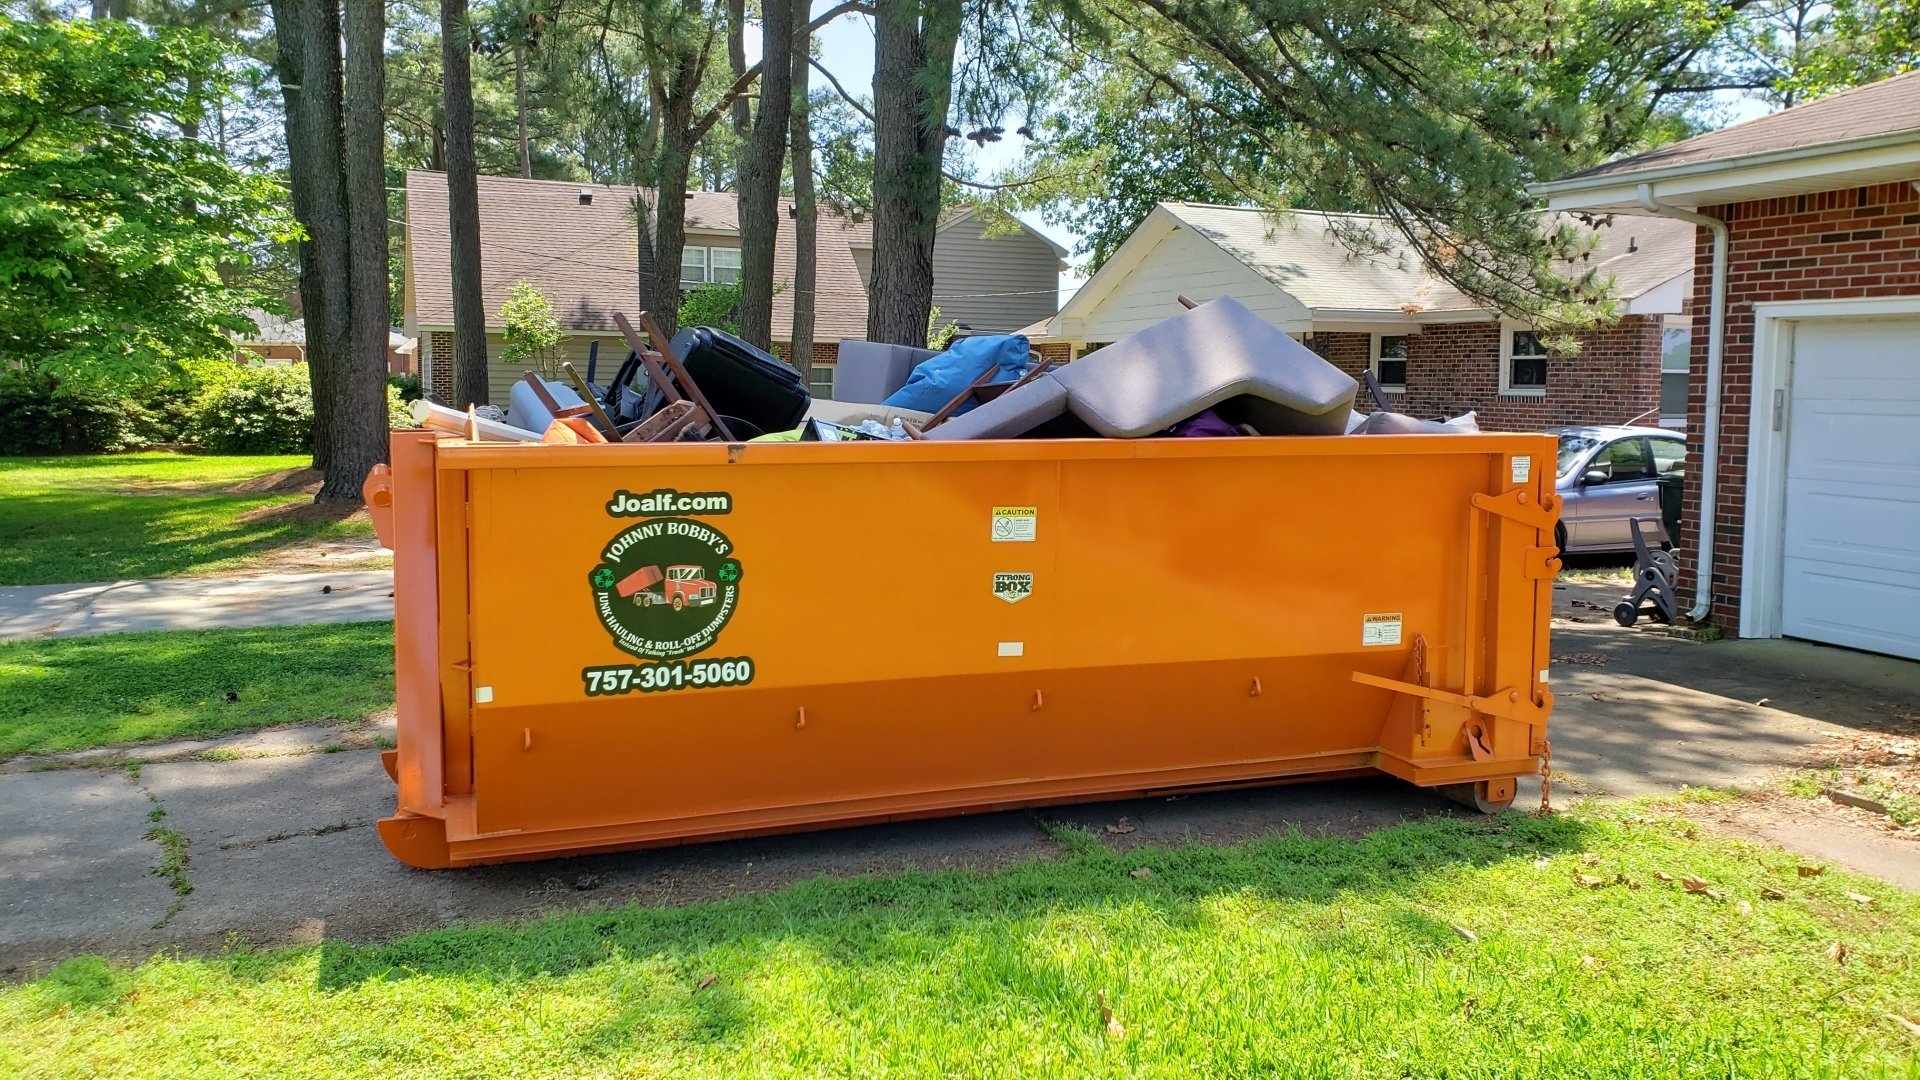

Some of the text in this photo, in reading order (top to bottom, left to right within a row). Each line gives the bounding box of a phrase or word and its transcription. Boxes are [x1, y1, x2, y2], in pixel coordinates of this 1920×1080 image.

[611, 494, 727, 512] Joalf.com
[606, 522, 728, 563] JOHNNY BOBBY'S
[995, 581, 1030, 592] BOX
[597, 585, 735, 650] JUNK HAULING & ROLL-OFF DUMPSTERS
[619, 639, 639, 651] Instead
[645, 649, 665, 657] Talking
[587, 661, 750, 692] 757-301-5060
